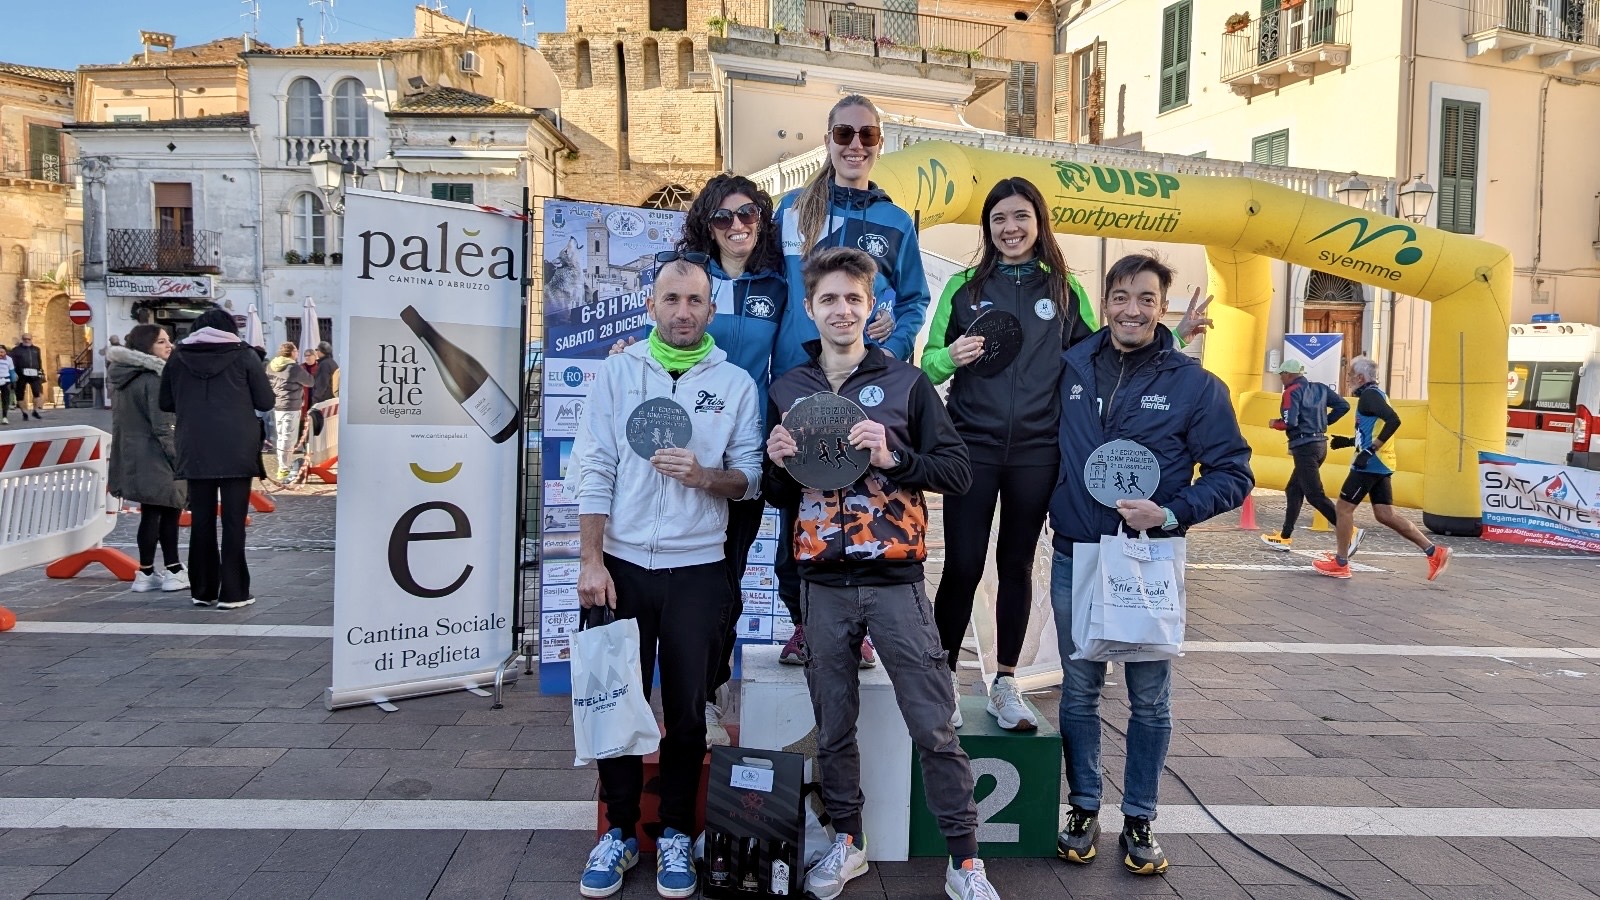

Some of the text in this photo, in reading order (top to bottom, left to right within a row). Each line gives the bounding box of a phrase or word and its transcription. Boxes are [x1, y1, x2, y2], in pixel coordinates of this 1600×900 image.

[1090, 165, 1181, 200] UISP
[1049, 205, 1182, 233] sportpertutti
[1317, 250, 1403, 282] syemme
[108, 277, 193, 296] Bim Bum Bar
[388, 274, 491, 291] CANTINA D'ABRUZZO
[581, 301, 605, 324] 6-8
[608, 297, 618, 317] H
[555, 312, 650, 352] SABATO 28 DICEM
[379, 404, 422, 419] eleganza
[820, 406, 857, 415] EDIZIONE
[1535, 401, 1570, 409] AMBULANZA
[1120, 449, 1148, 457] EDIZIONE
[1485, 471, 1531, 495] SAT
[1486, 513, 1527, 524] Pagamenti
[1113, 583, 1133, 593] Stile
[346, 612, 507, 647] Cantina Sociale
[374, 645, 481, 673] di Paglieta
[969, 757, 1021, 843] 2
